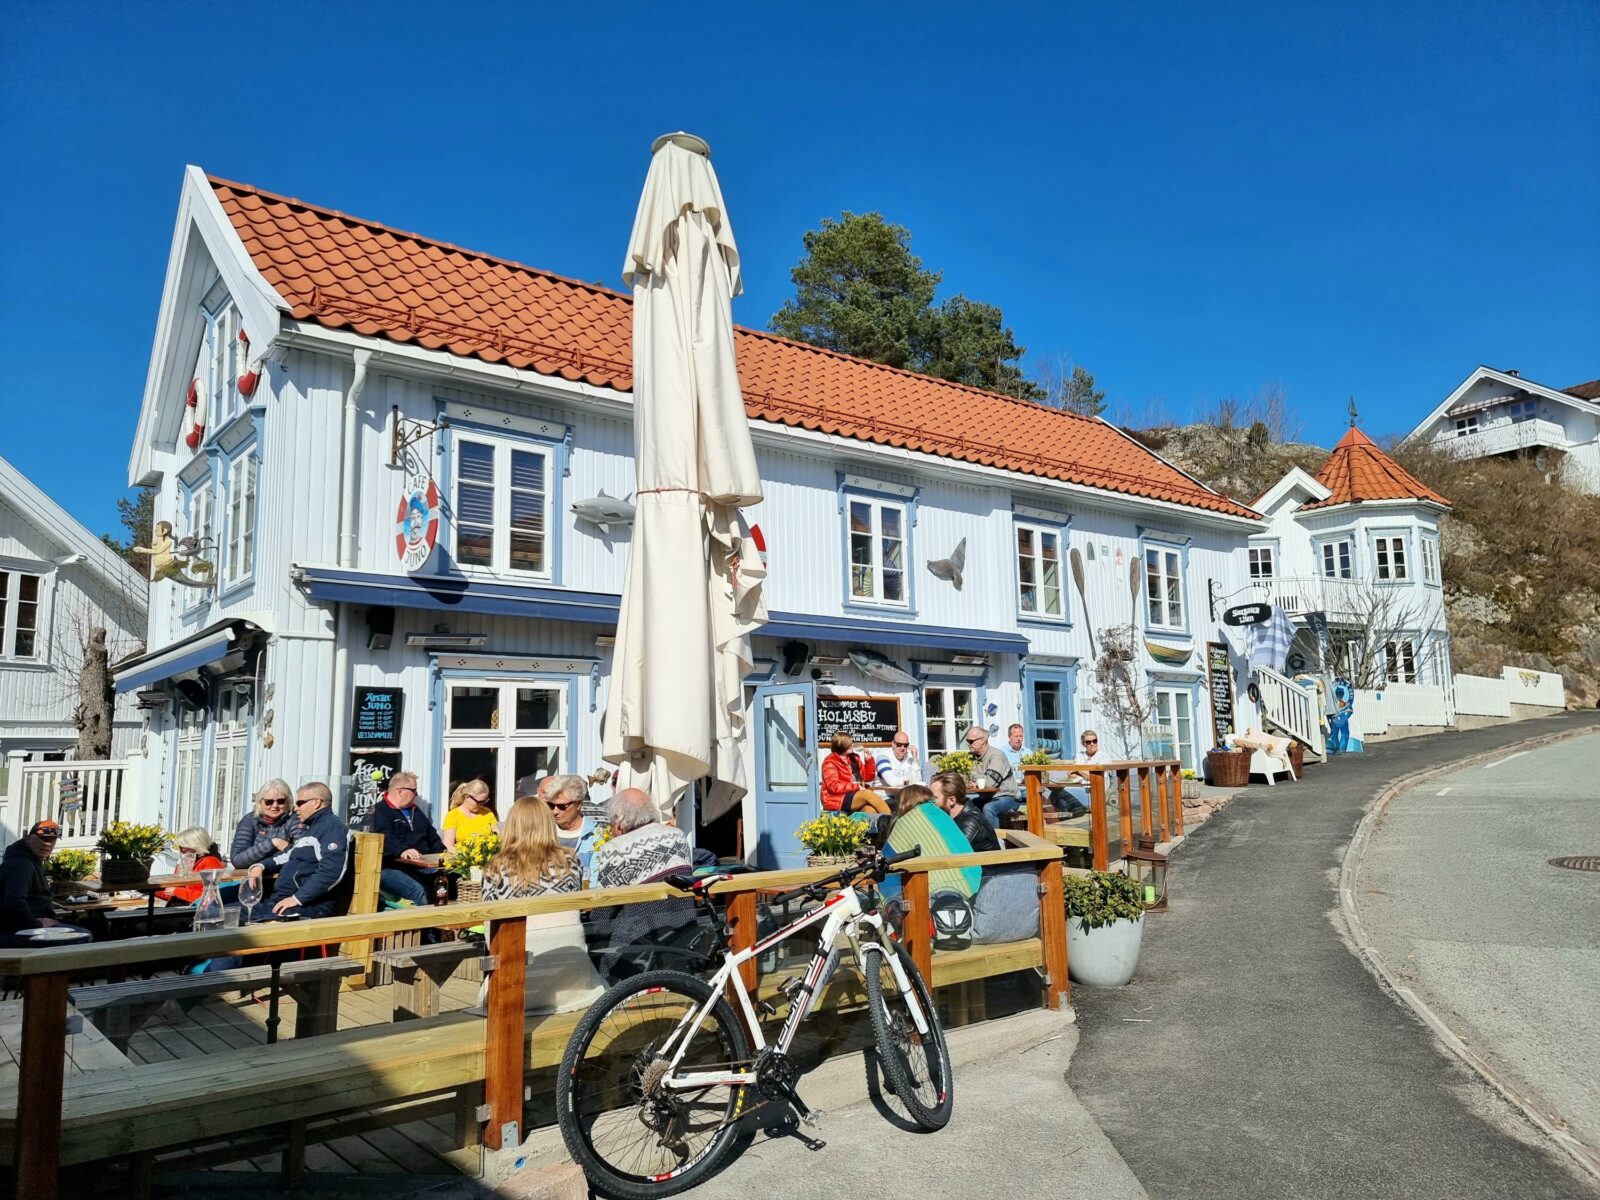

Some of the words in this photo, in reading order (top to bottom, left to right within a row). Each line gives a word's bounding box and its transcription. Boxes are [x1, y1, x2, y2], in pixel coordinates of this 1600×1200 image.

[405, 545, 427, 567] JUNO
[361, 702, 392, 711] JUNO
[860, 700, 871, 708] TIL
[818, 709, 876, 723] HOLMSBU
